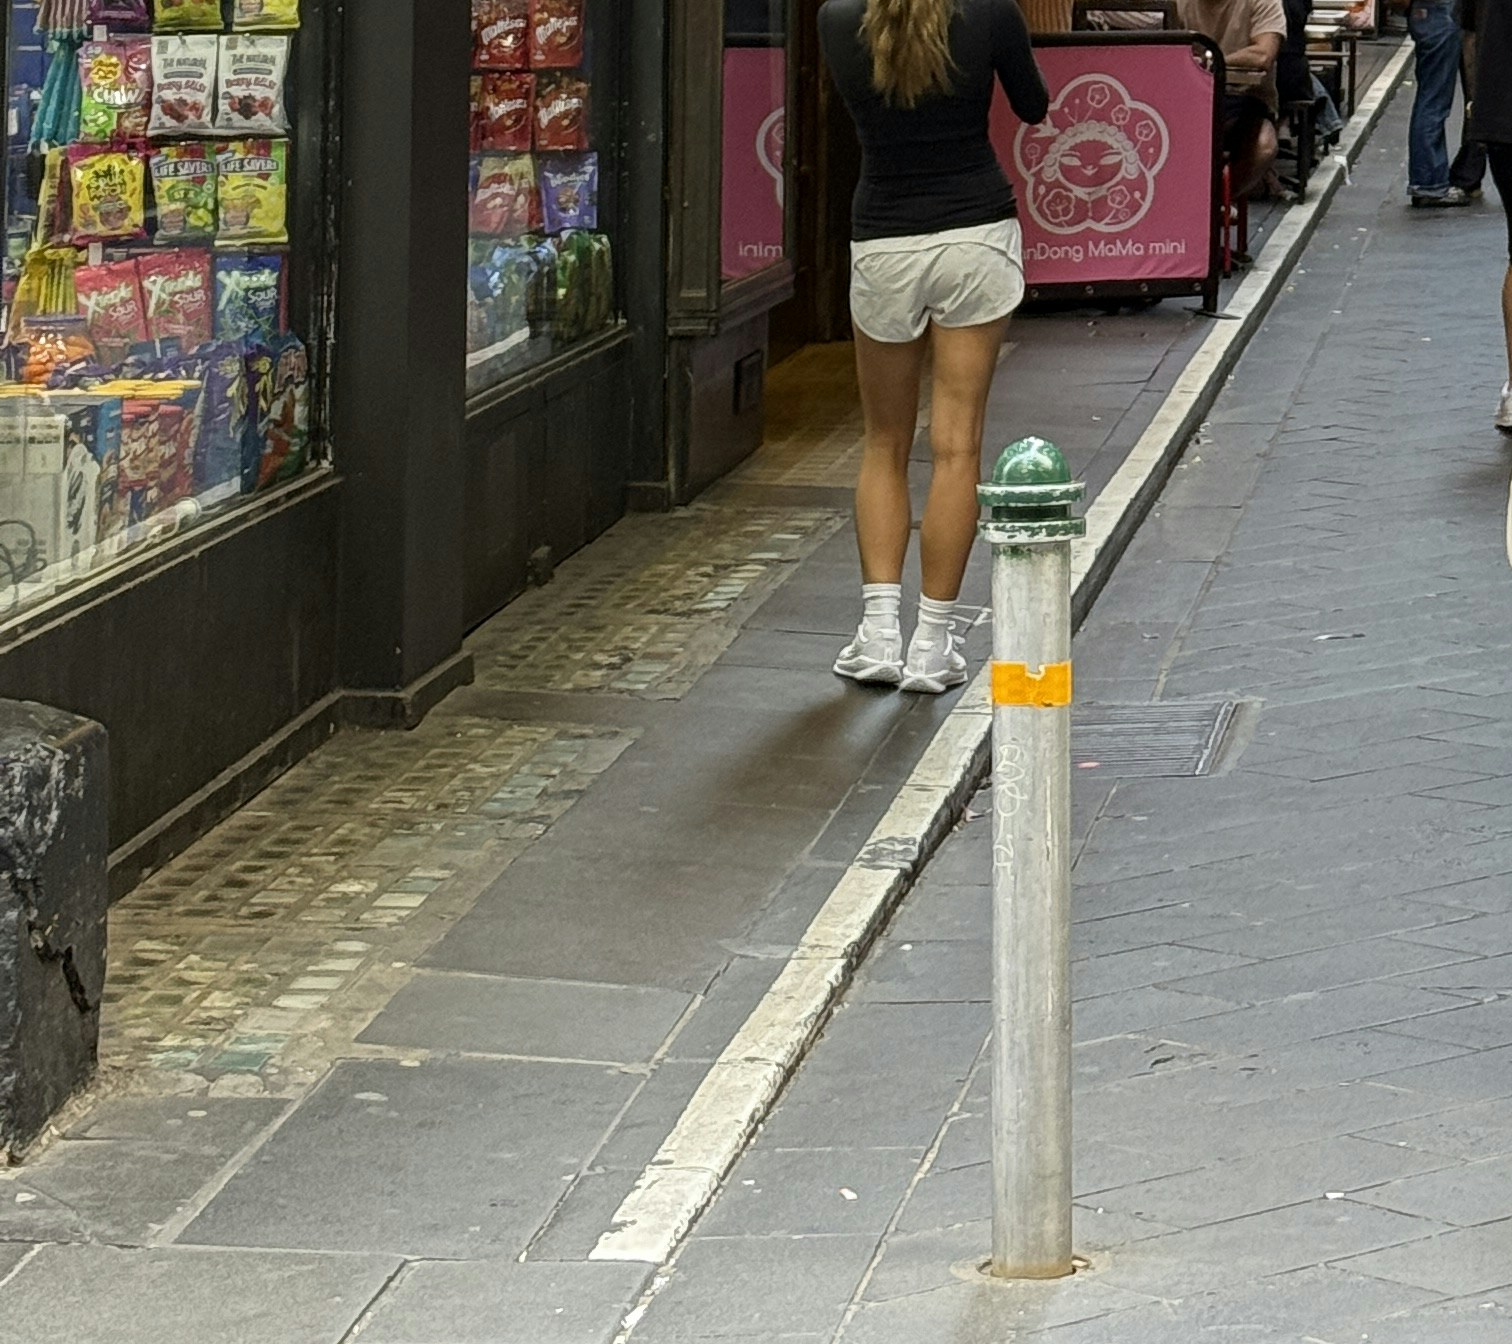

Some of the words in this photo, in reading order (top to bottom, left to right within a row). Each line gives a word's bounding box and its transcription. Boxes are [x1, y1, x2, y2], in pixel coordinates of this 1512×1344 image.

[155, 163, 177, 177] LIFE
[222, 160, 243, 173] LIFE
[1088, 237, 1144, 258] MaMa
[1149, 238, 1186, 255] mini
